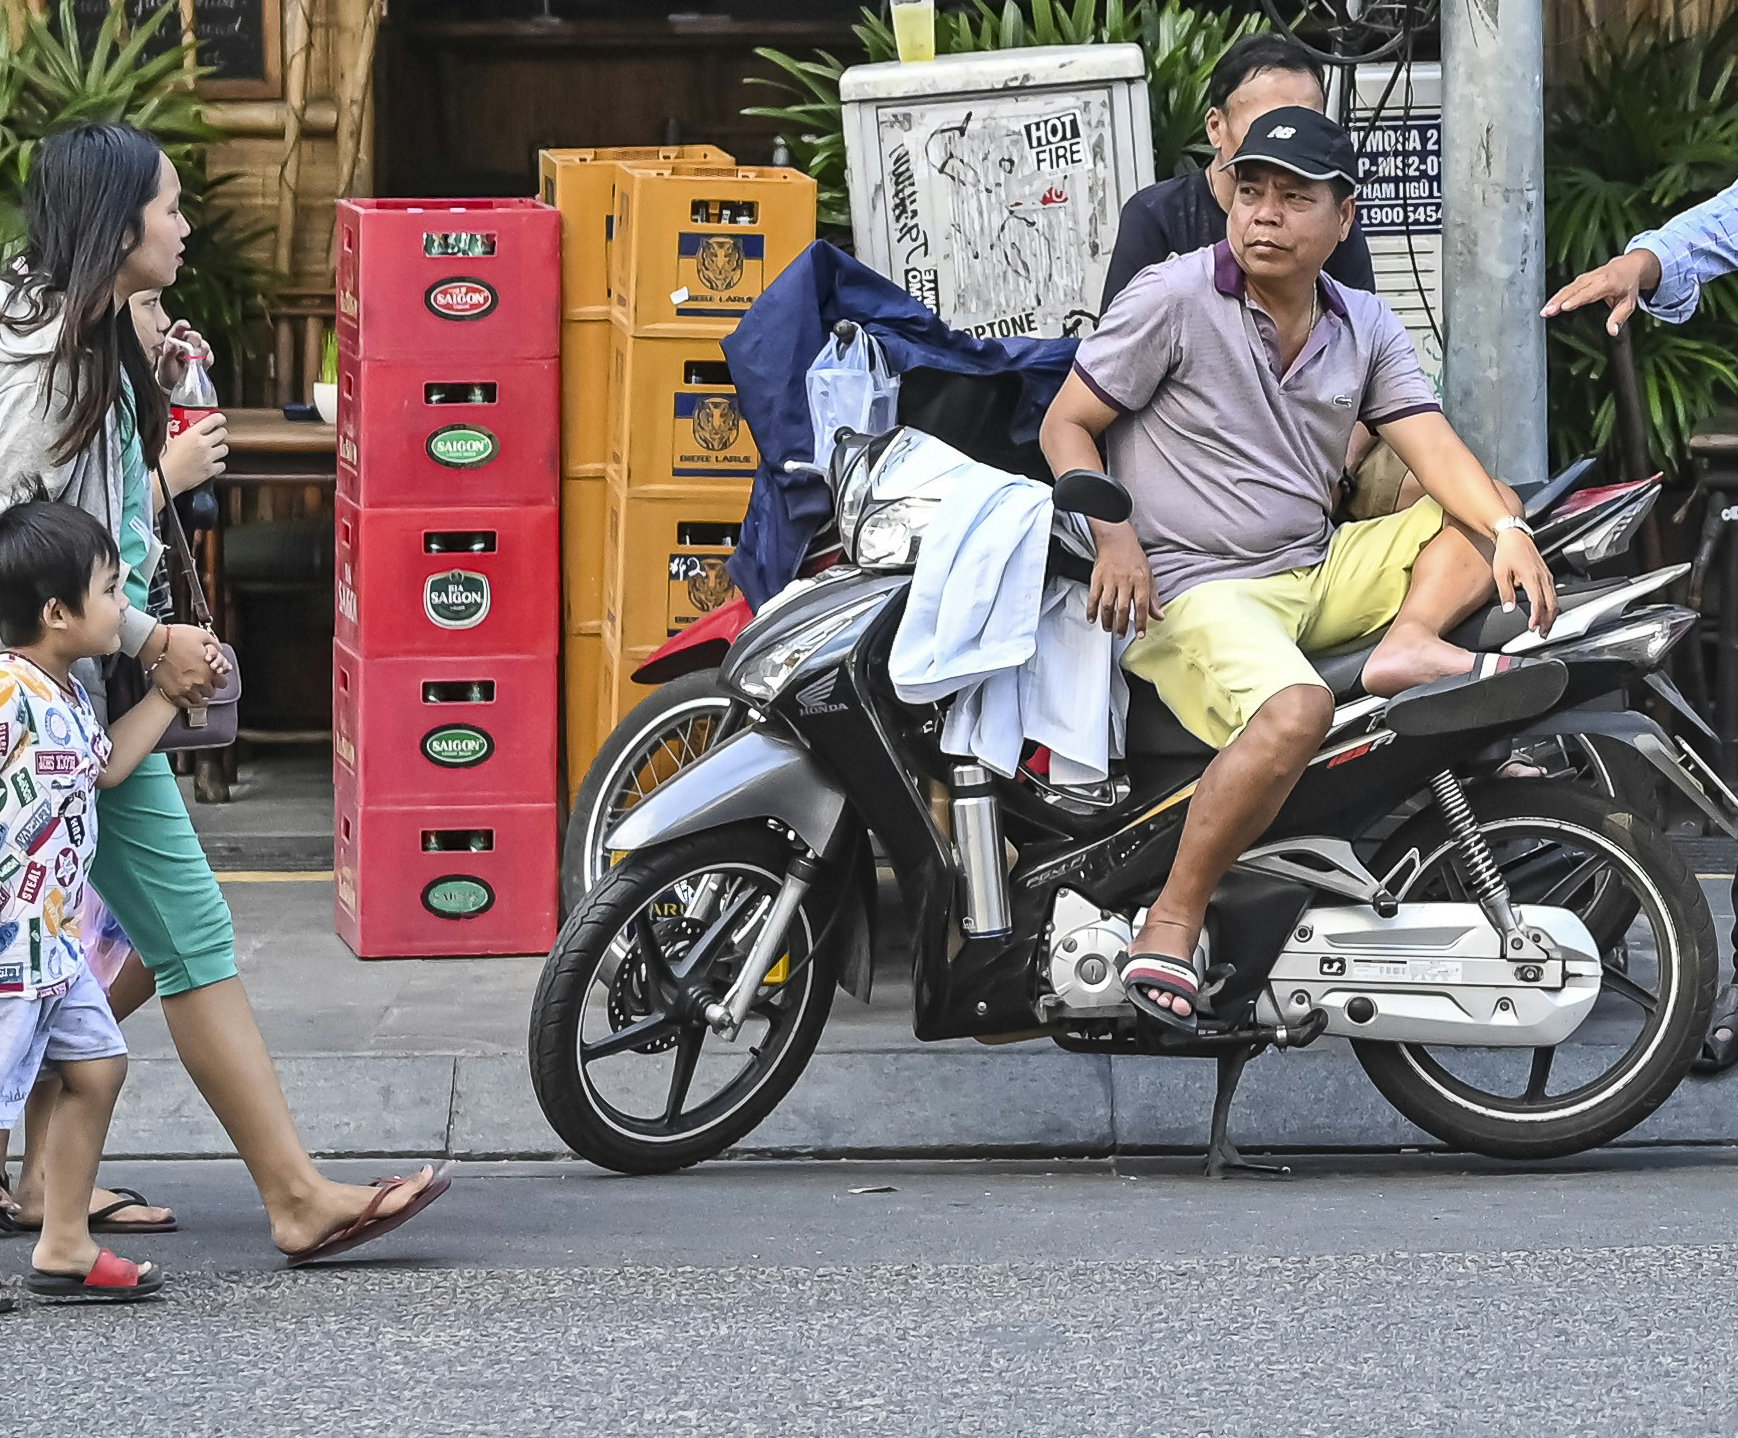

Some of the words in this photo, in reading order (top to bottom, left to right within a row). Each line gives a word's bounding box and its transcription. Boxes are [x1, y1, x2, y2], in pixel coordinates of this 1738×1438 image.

[1030, 114, 1074, 147] HOT
[1426, 129, 1439, 151] 2
[1035, 141, 1082, 171] FIRE
[436, 292, 485, 305] SAIGON
[436, 439, 485, 452] SAIGON
[431, 590, 482, 604] SAIGON
[799, 702, 849, 716] HONDA
[432, 739, 481, 752] SAIGON
